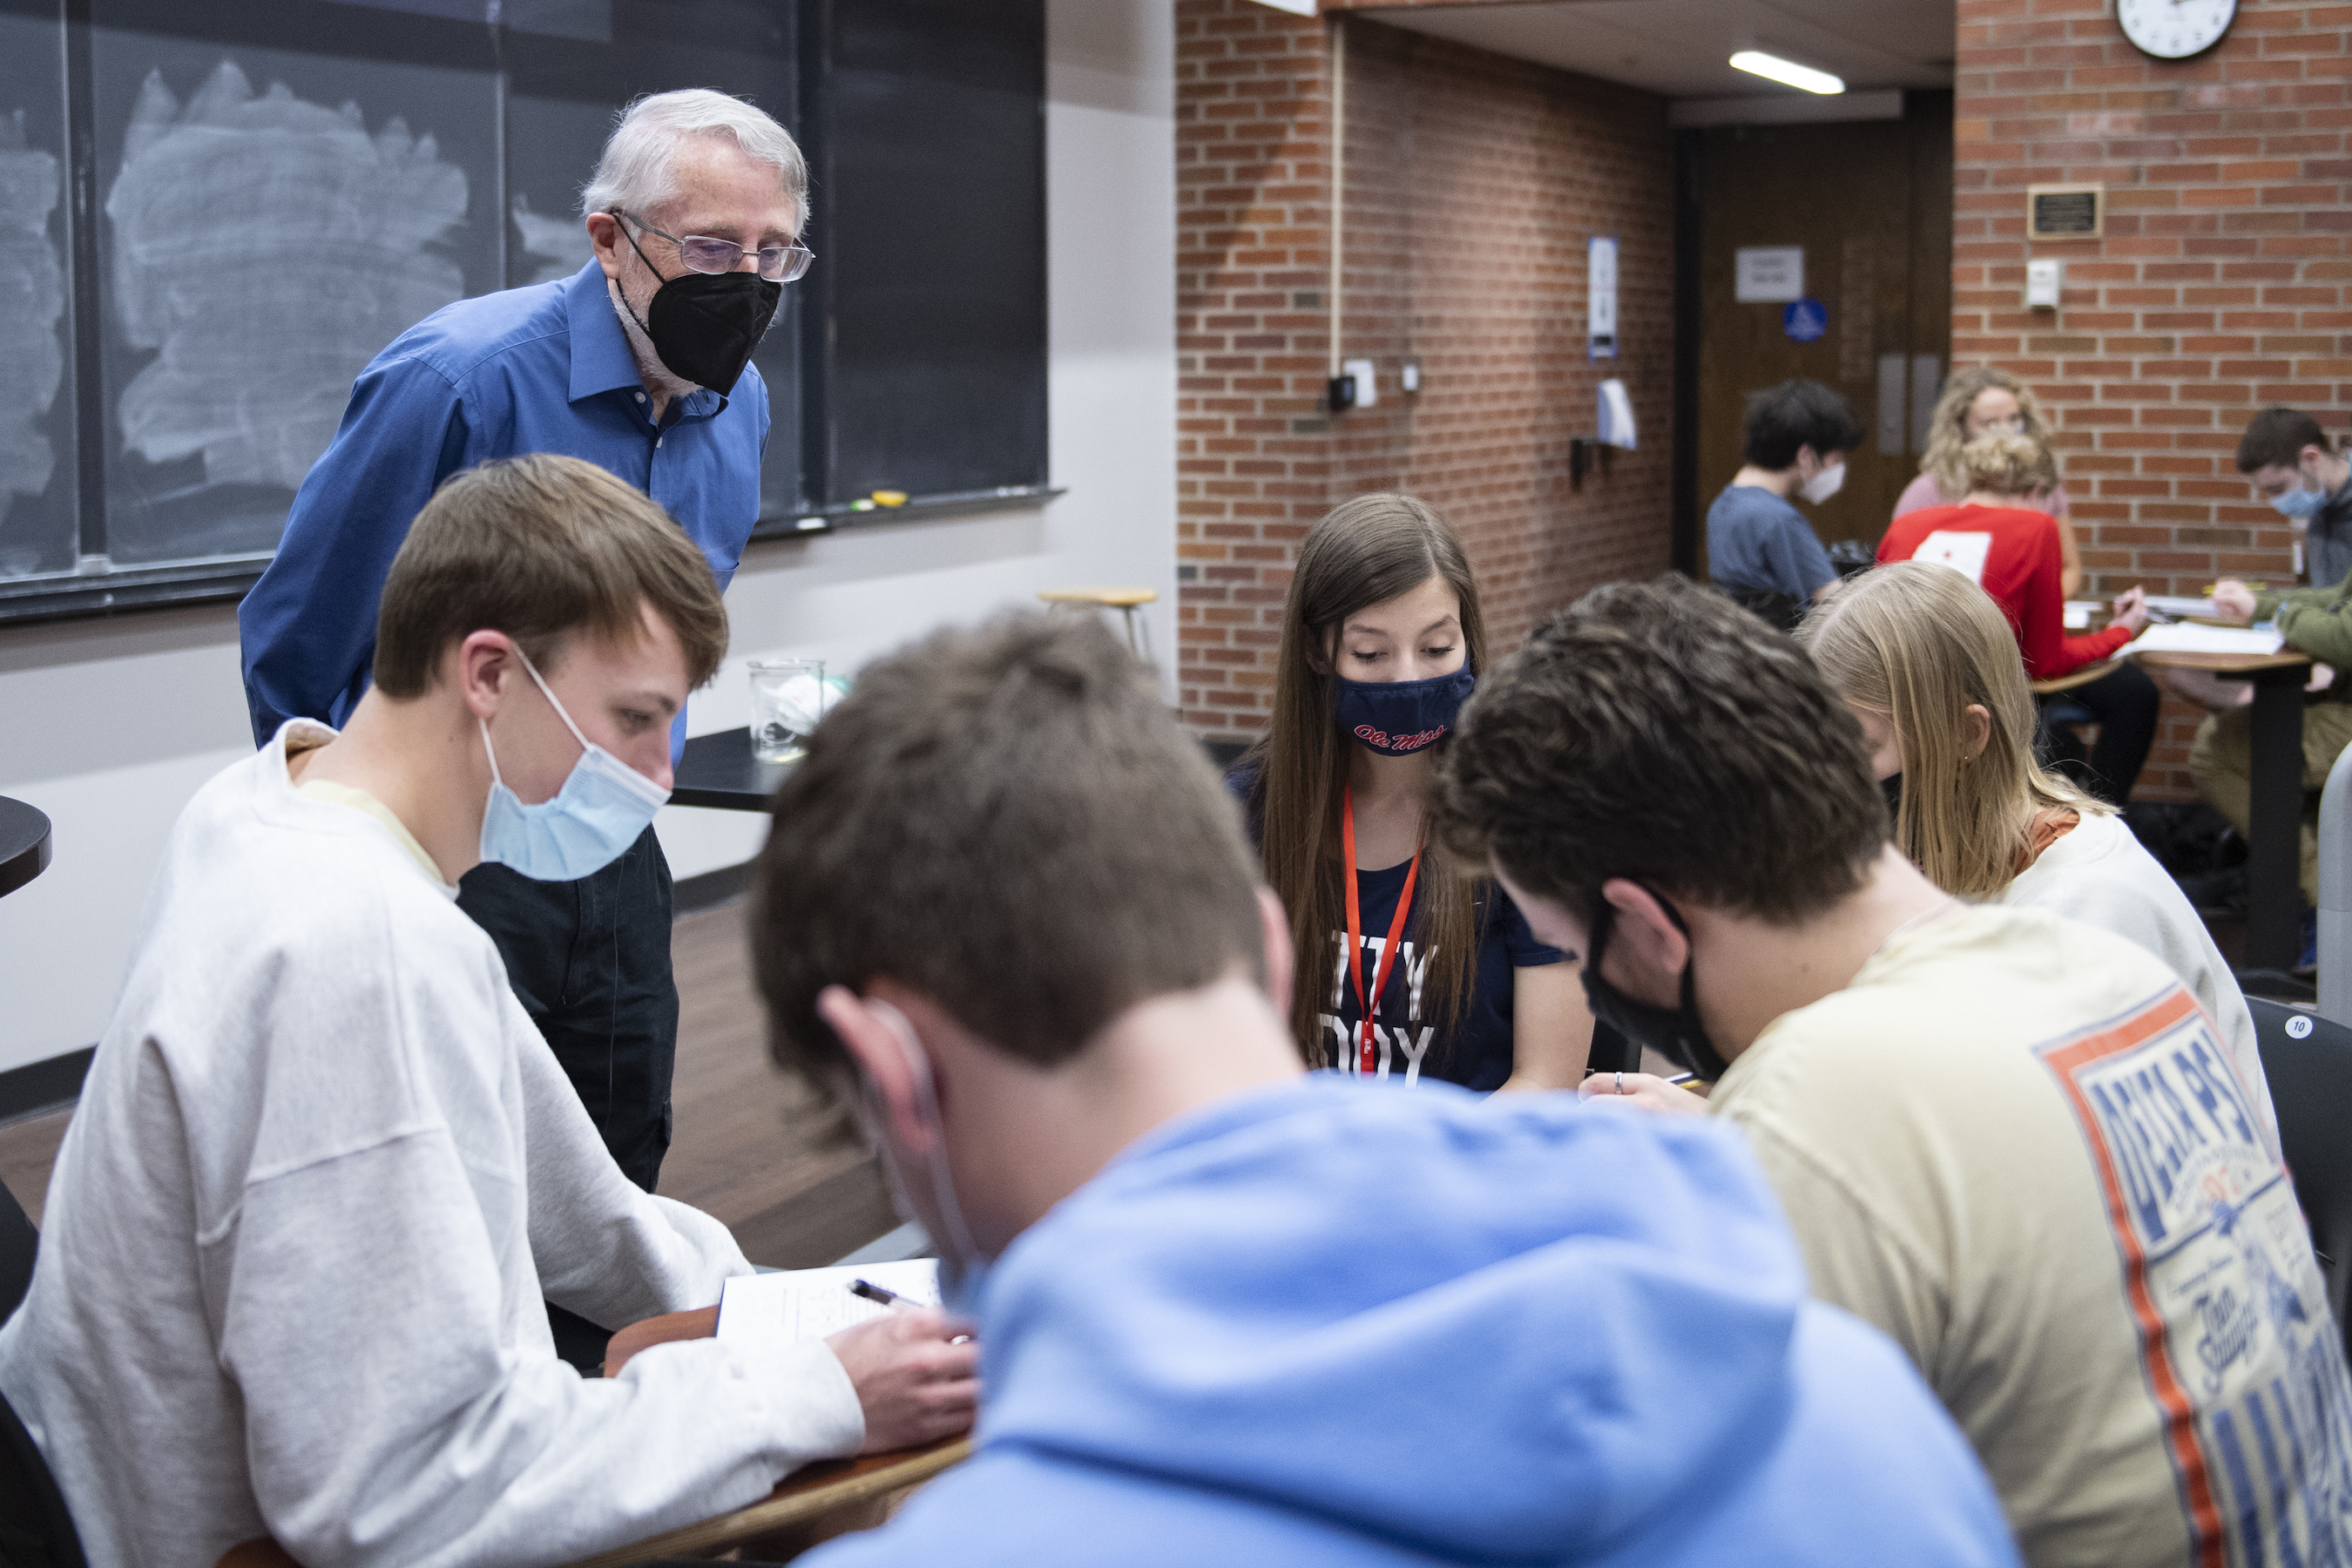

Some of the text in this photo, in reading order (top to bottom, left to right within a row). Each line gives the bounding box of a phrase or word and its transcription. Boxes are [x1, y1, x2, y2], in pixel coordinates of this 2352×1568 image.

[1354, 724, 1445, 750] Ole Miss
[2294, 1020, 2306, 1032] 10
